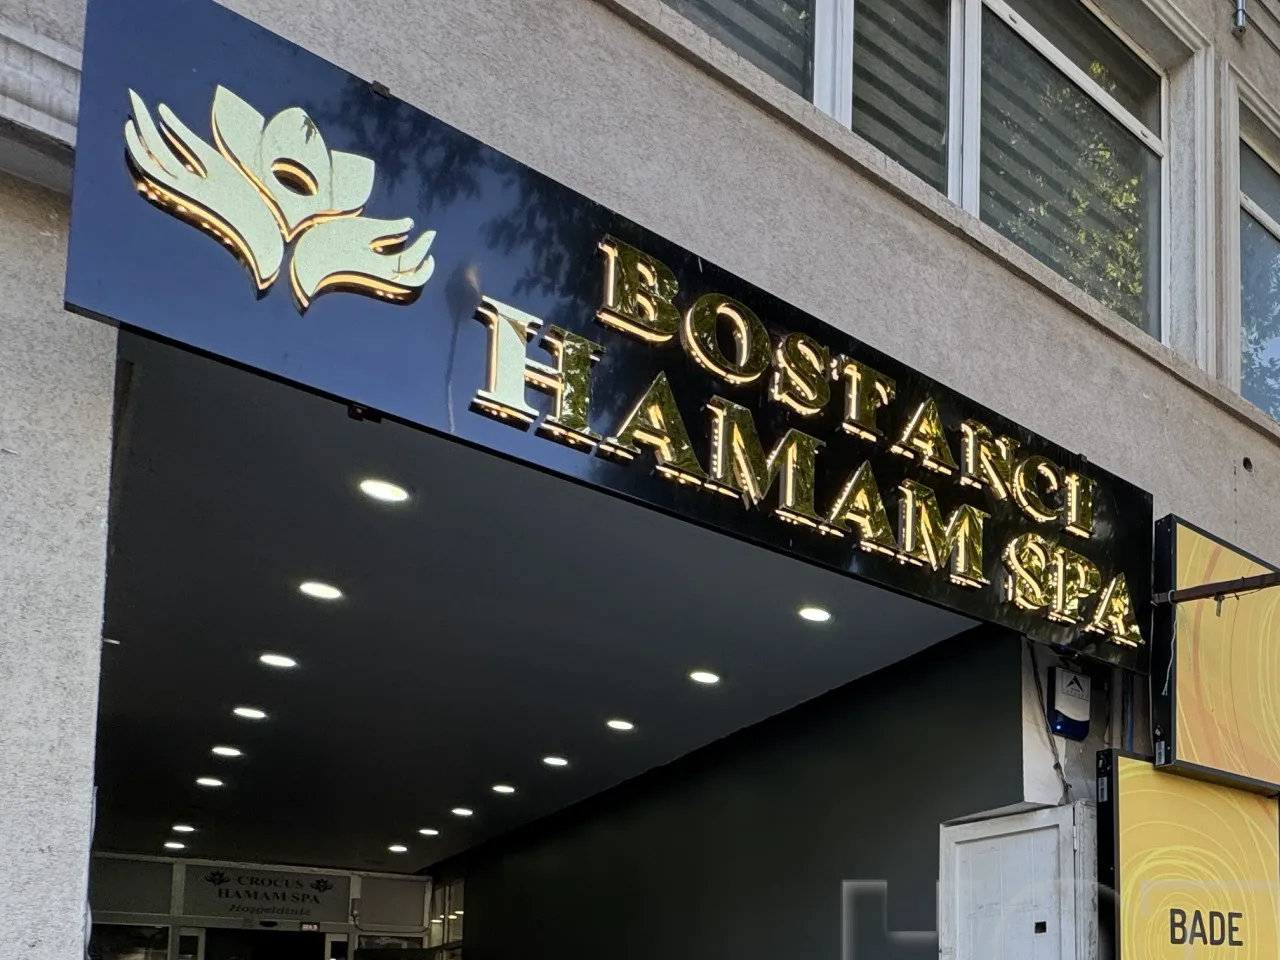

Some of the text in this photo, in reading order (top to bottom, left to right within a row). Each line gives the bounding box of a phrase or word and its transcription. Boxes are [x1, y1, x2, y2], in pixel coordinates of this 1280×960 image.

[597, 235, 1098, 539] BOSTANCI
[468, 295, 1145, 648] HAMAM SPA
[218, 888, 320, 904] HAMAM SPA
[237, 875, 304, 889] CROCUS
[1170, 908, 1243, 946] BADE
